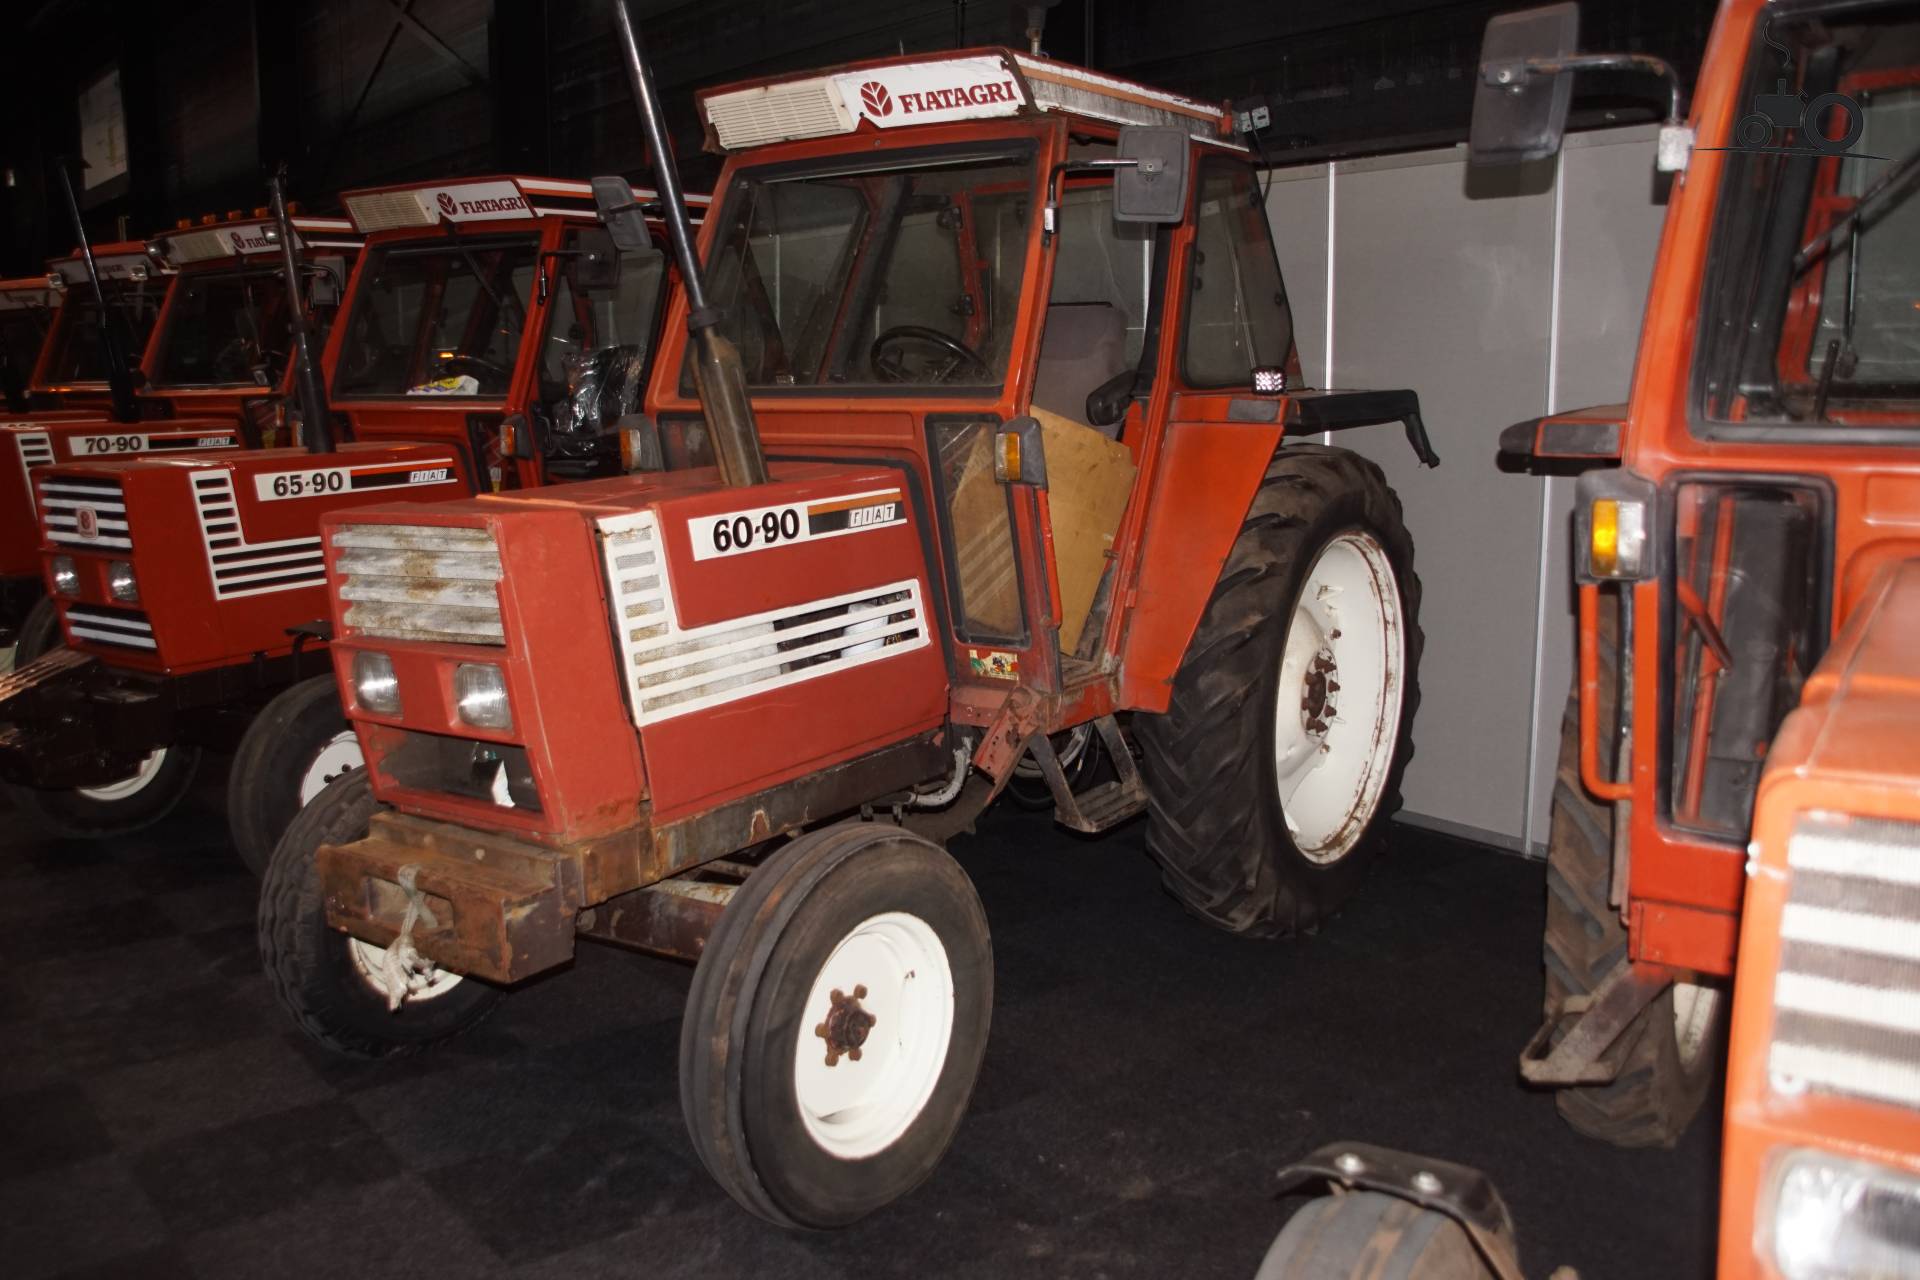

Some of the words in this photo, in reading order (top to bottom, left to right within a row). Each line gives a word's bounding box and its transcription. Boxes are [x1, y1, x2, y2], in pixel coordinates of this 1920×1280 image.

[898, 80, 1017, 114] FIATAGRI
[459, 196, 527, 214] FIATAGRI
[85, 436, 142, 453] 70-90
[199, 437, 230, 447] FIAT
[273, 471, 344, 497] 65-90
[411, 469, 448, 482] FIAT
[851, 504, 895, 526] FIAT
[712, 508, 801, 553] 60-90
